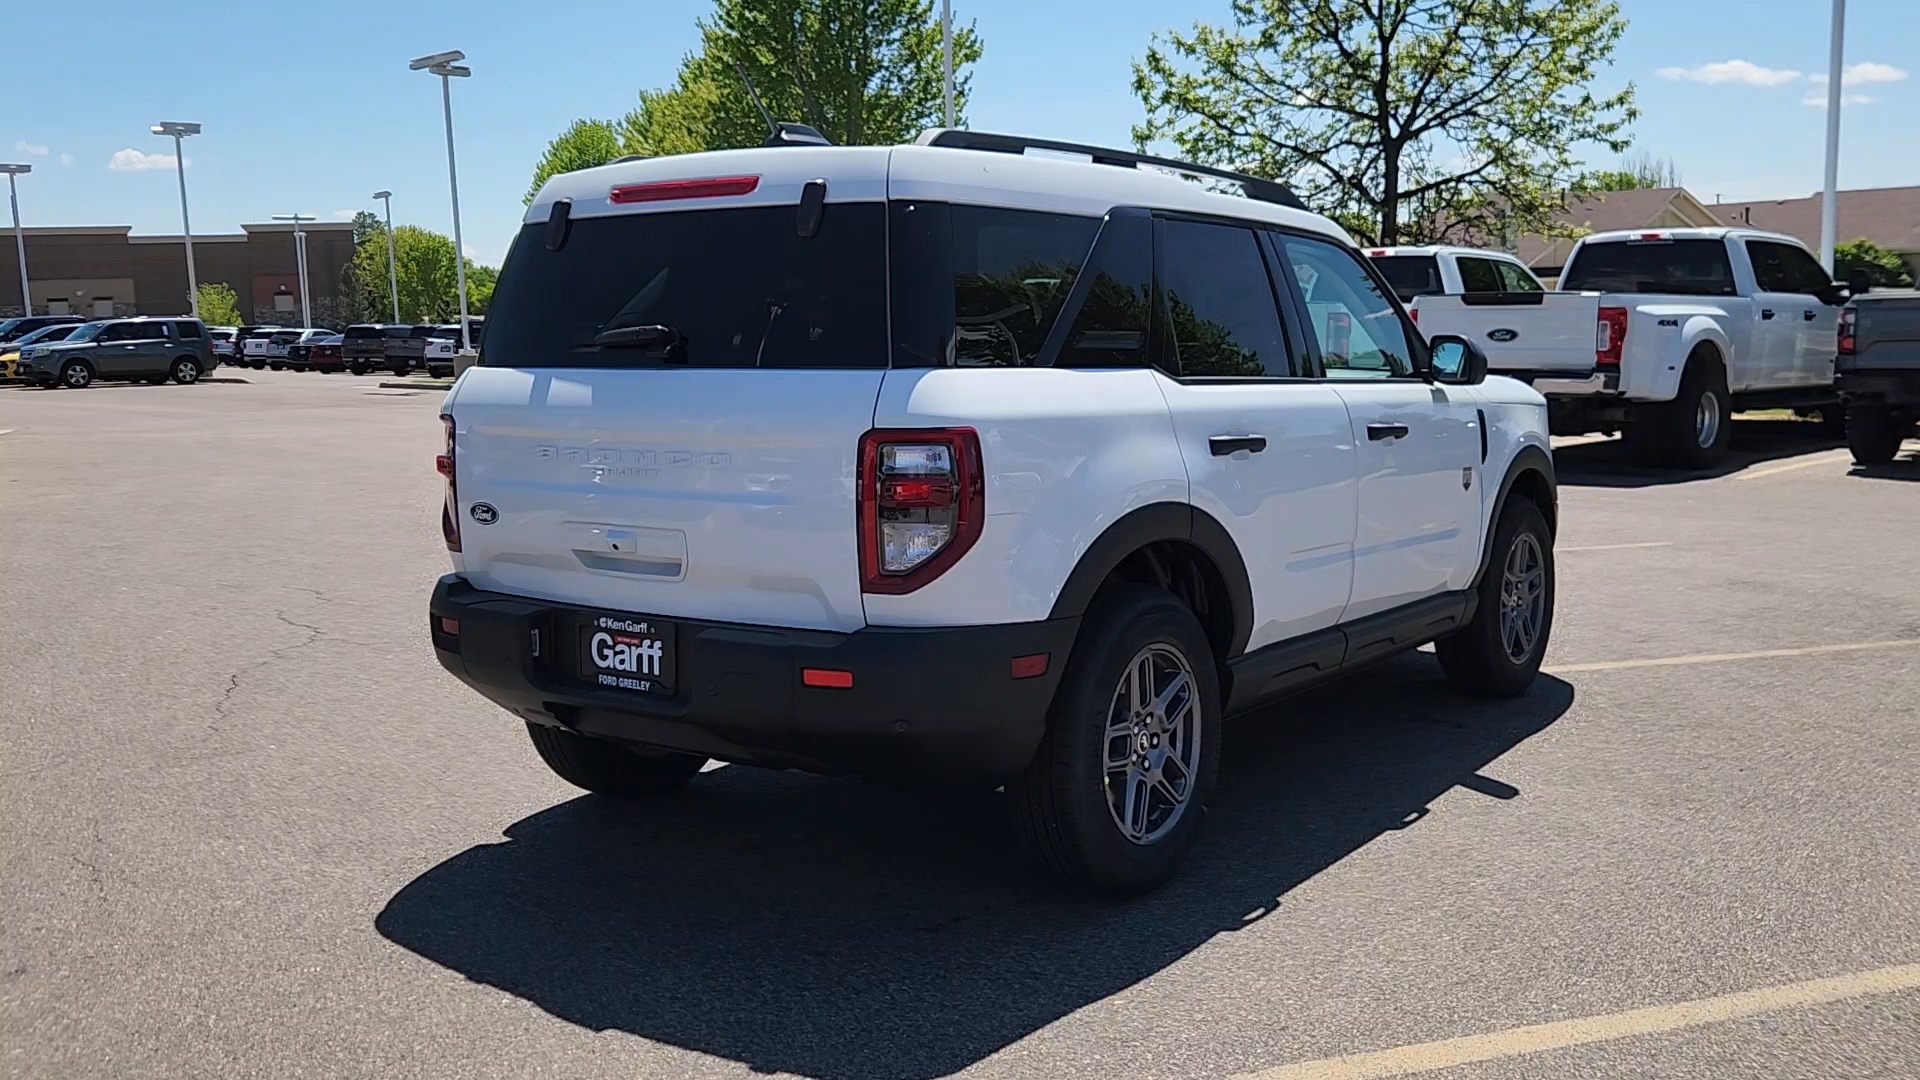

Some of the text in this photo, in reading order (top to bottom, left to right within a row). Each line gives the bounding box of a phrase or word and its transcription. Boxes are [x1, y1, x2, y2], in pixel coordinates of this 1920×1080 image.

[536, 444, 732, 468] BRONCO
[591, 632, 662, 675] Garff
[599, 674, 650, 691] FORD GREELEY
